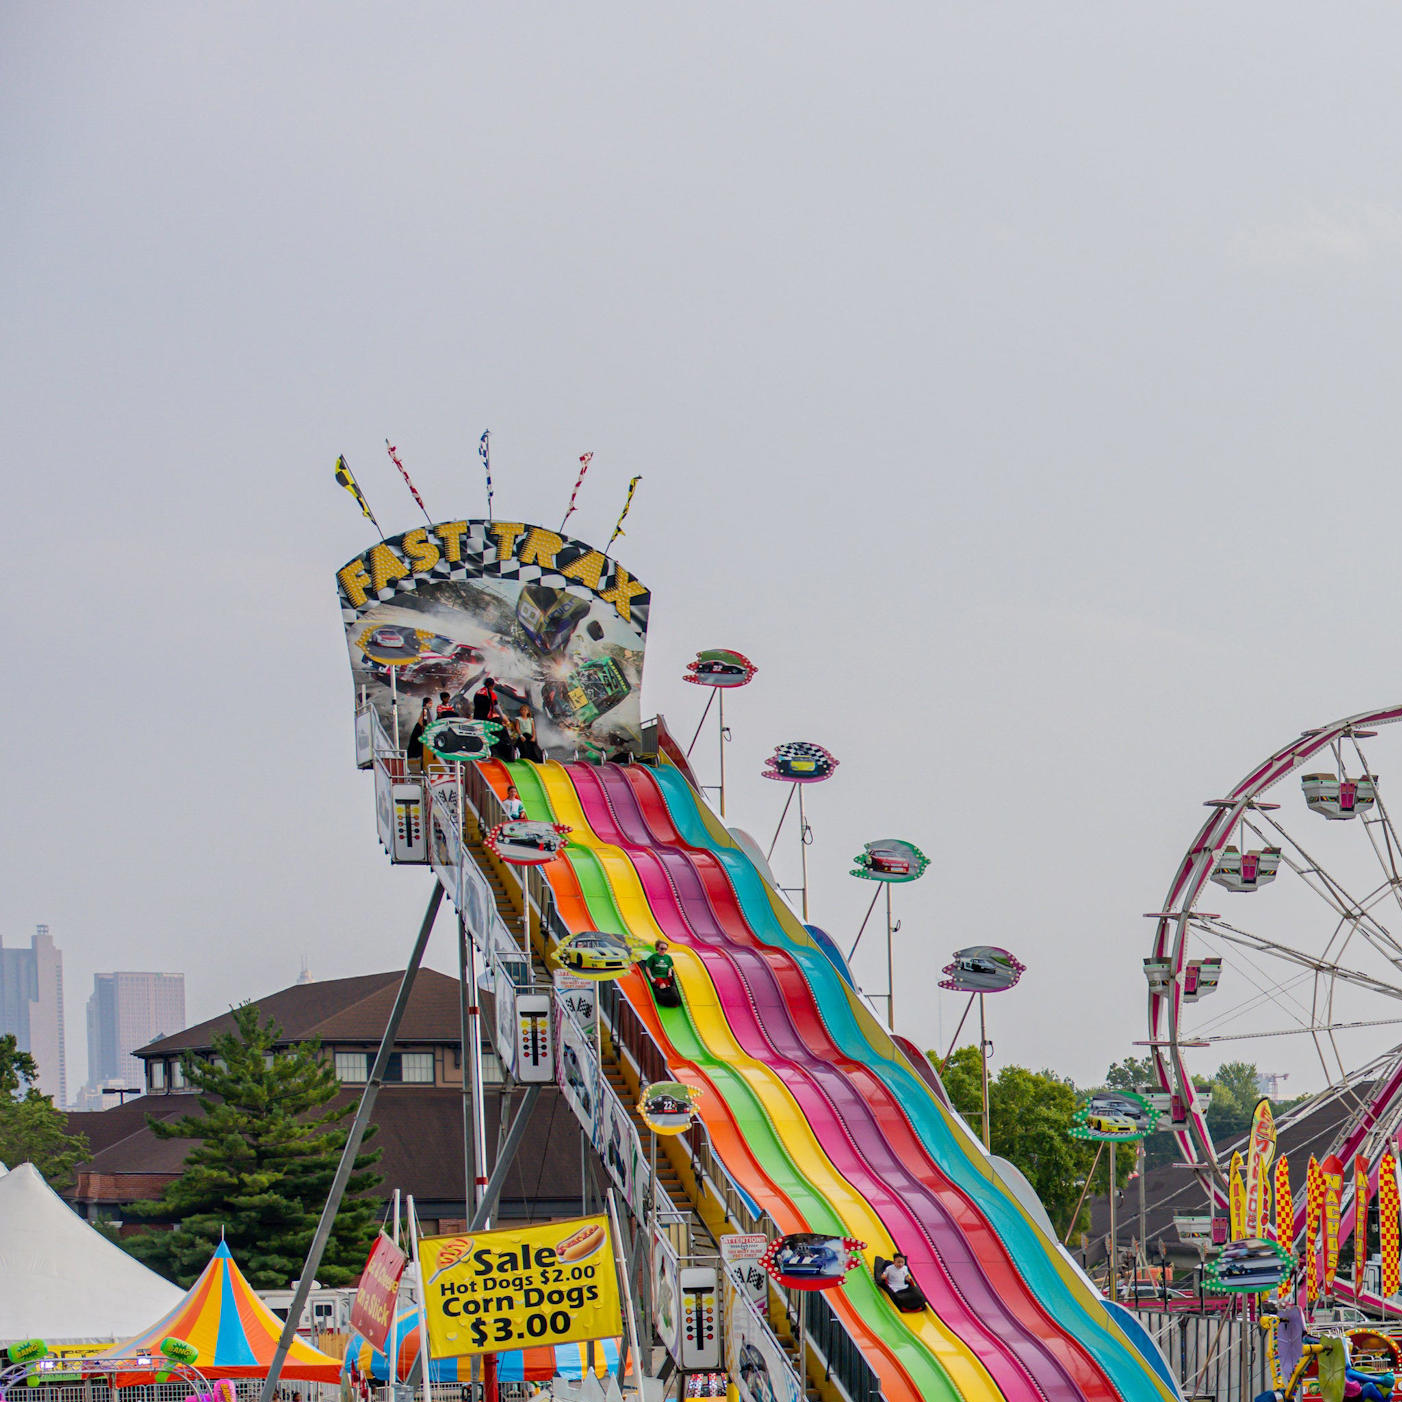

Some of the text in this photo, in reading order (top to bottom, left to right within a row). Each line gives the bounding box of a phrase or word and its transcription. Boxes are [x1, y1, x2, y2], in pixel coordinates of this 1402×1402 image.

[338, 521, 649, 624] FAST TRAX
[1324, 1172, 1343, 1269] NACHOS
[473, 1244, 556, 1276] Sale
[440, 1265, 595, 1296] Hot Dogs $2.00
[442, 1284, 599, 1317] Corn Dogs
[470, 1310, 571, 1348] $3.00
[16, 1343, 39, 1359] BANG!
[168, 1345, 193, 1358] BANG!
